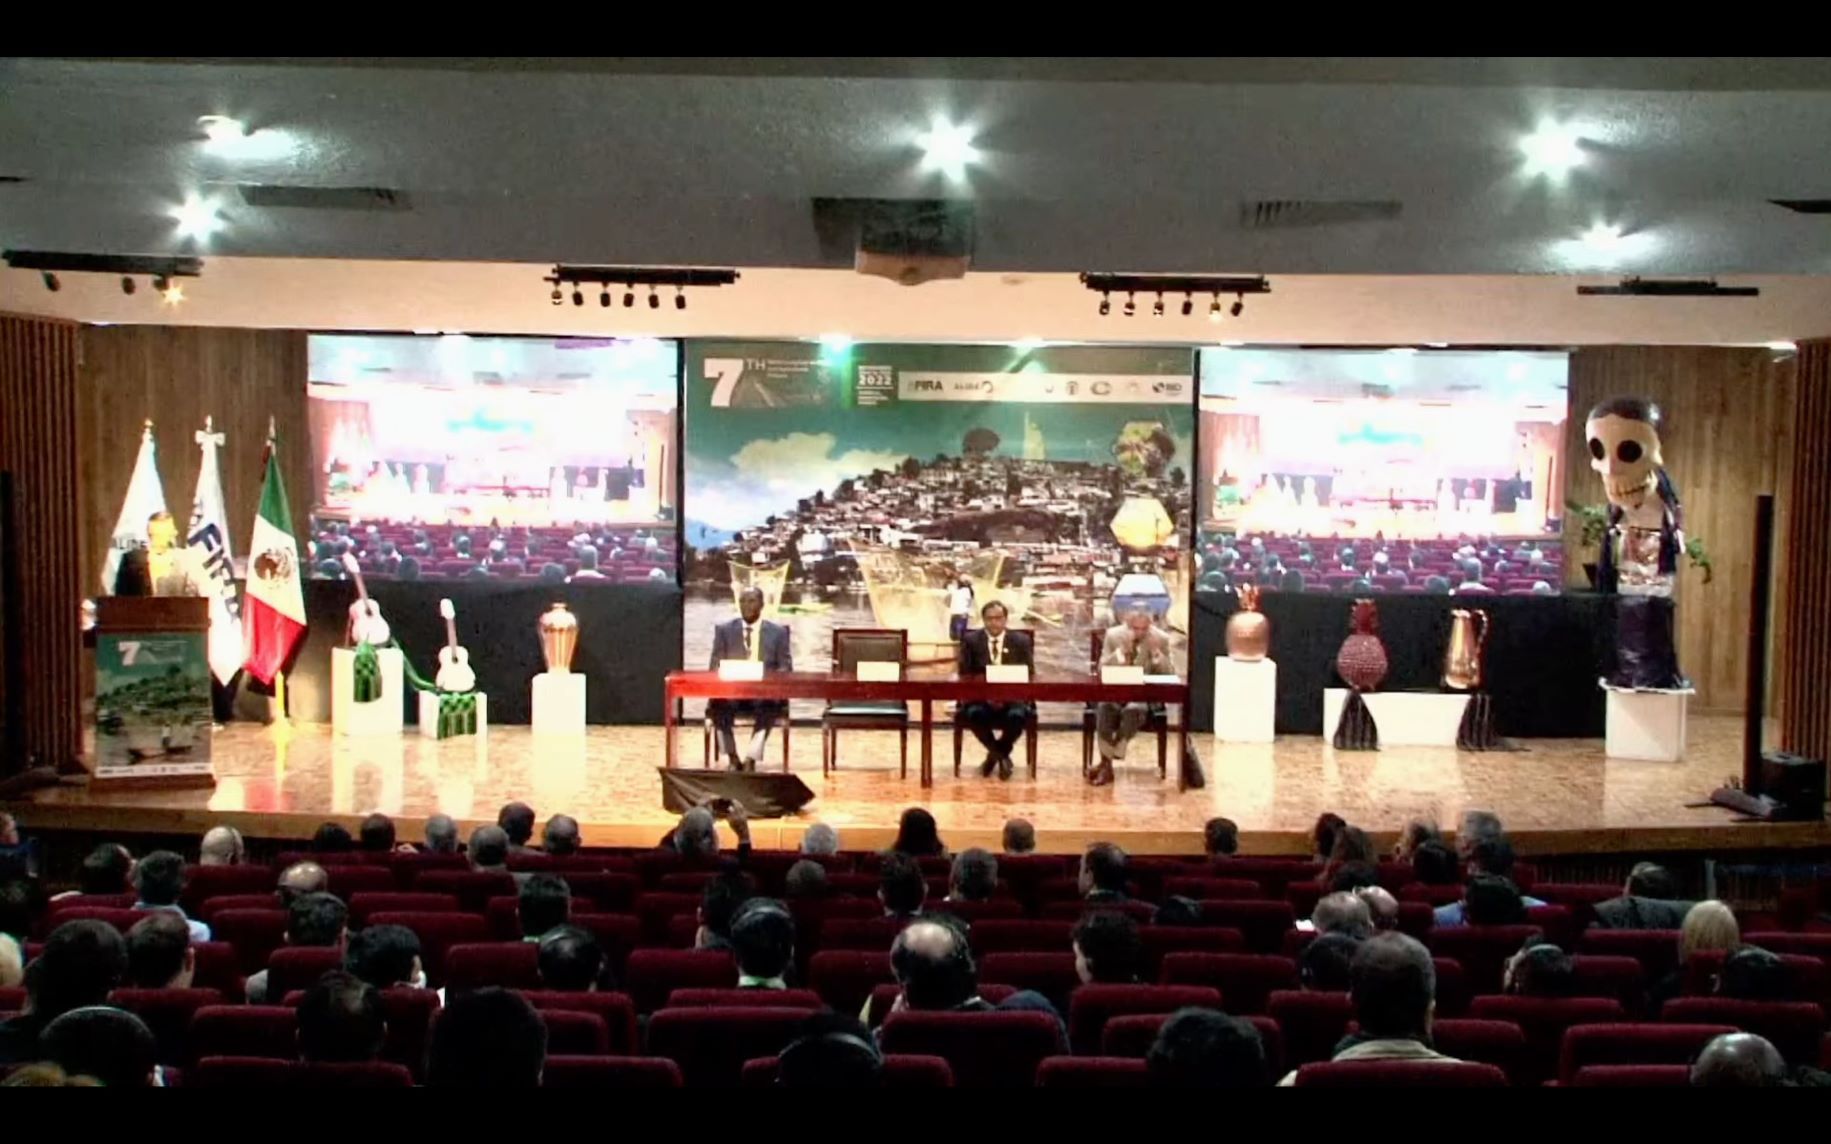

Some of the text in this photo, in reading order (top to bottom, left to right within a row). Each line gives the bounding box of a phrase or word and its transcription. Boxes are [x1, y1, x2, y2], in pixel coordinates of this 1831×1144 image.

[858, 374, 892, 386] 2022
[914, 380, 944, 391] FIRA
[118, 641, 141, 667] 7
